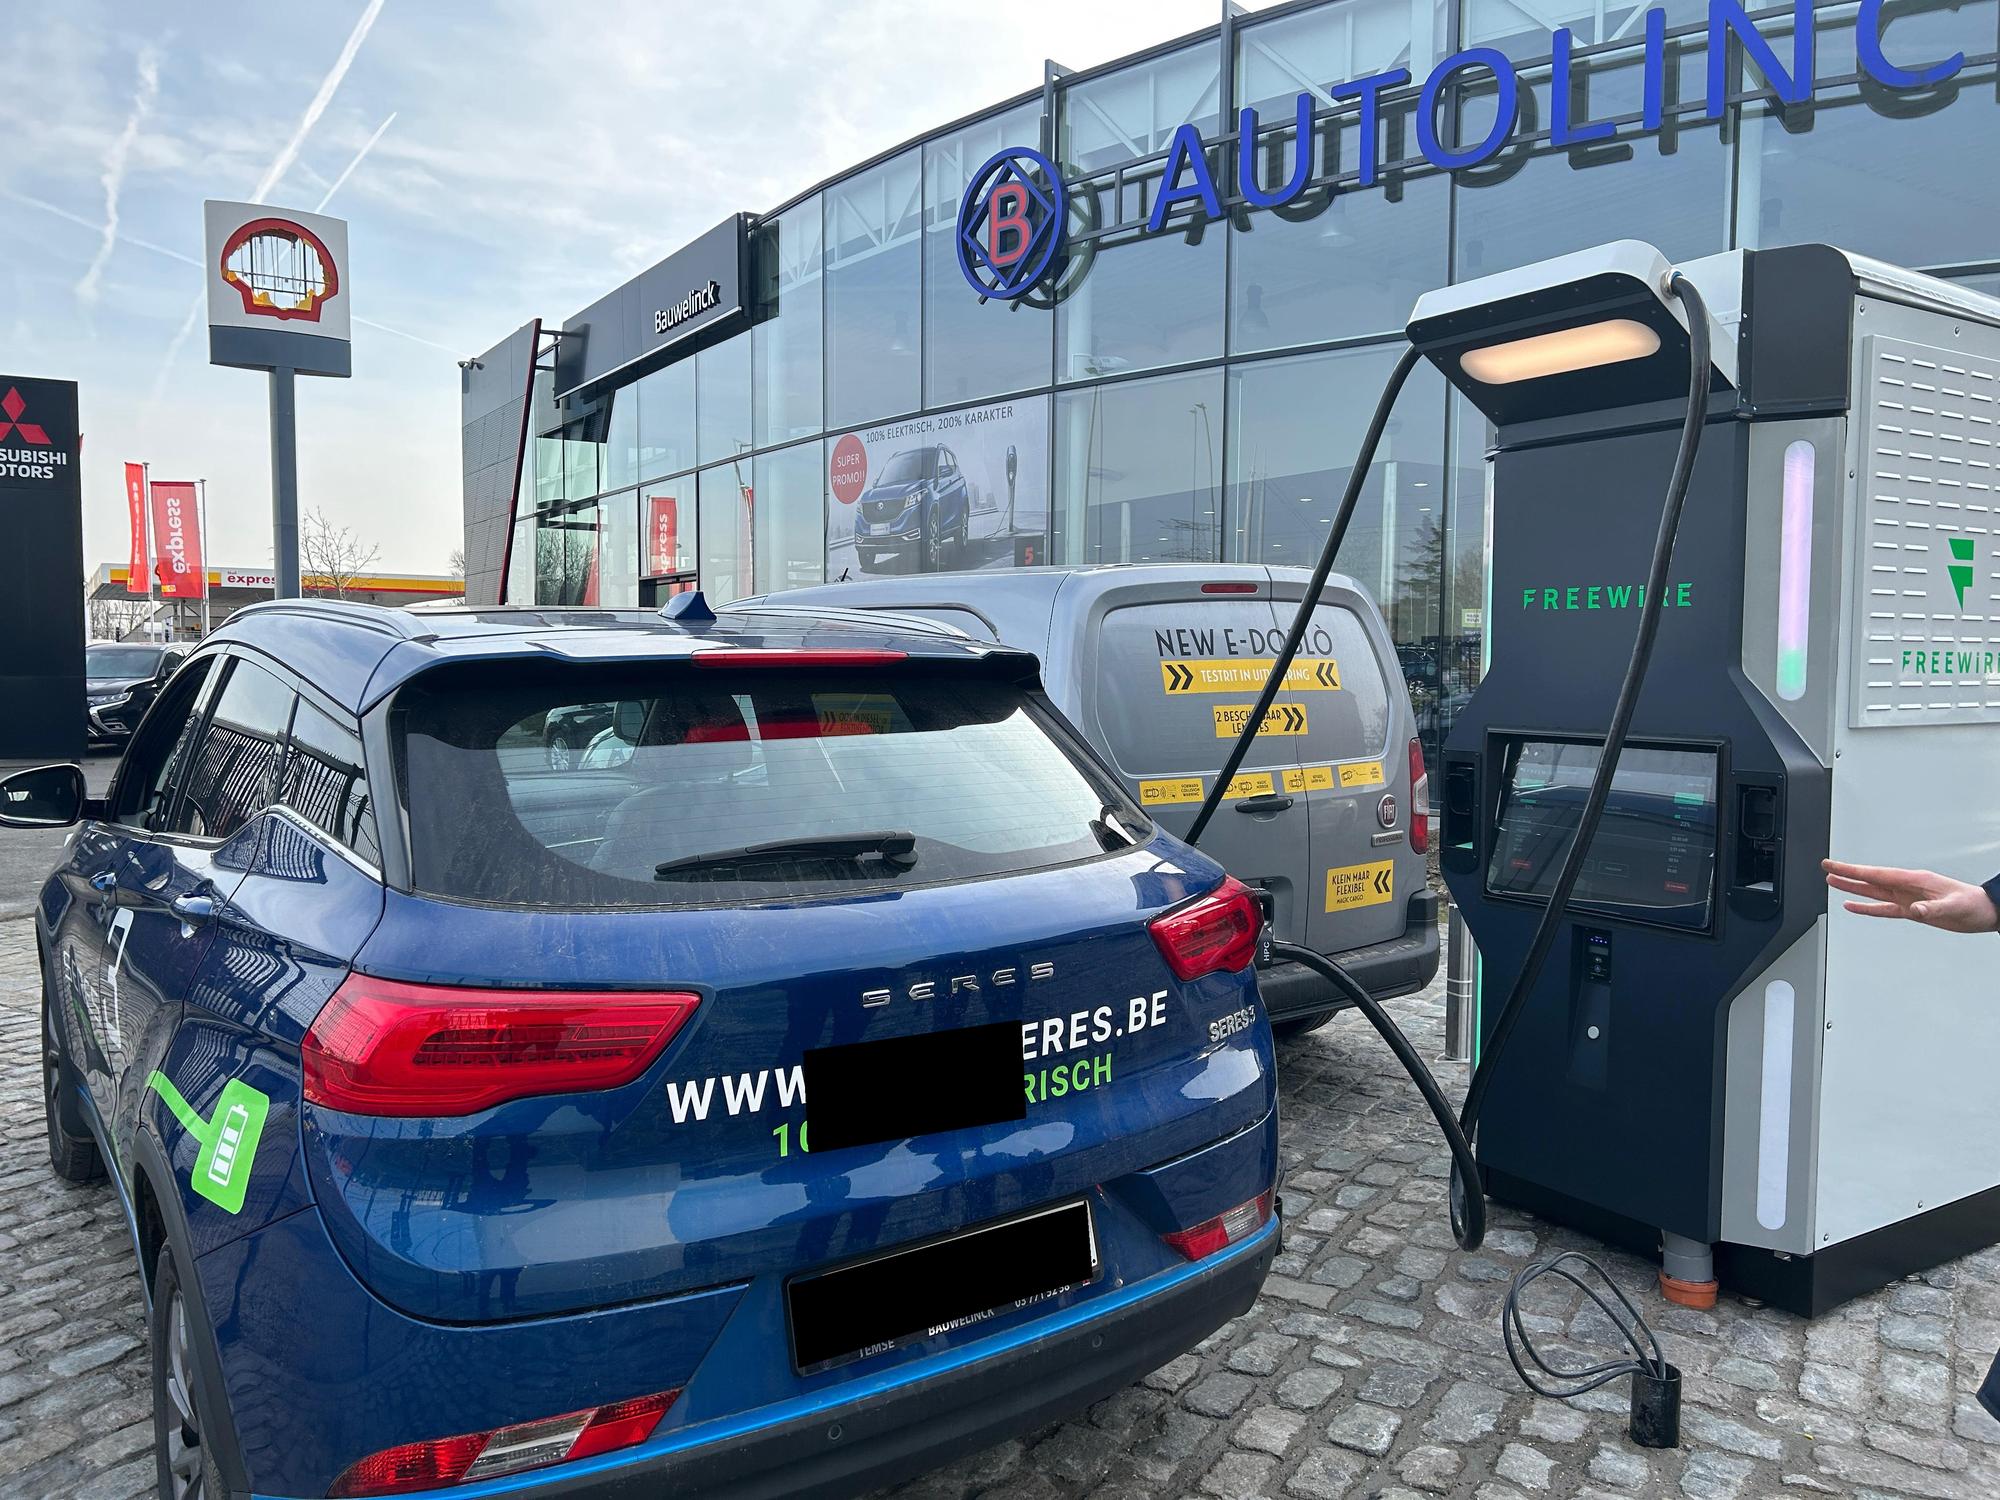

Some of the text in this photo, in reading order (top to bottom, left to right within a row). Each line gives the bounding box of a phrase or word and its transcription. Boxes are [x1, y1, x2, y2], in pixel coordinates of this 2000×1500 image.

[1148, 0, 1964, 232] AUTOLINC
[987, 180, 1032, 266] B
[654, 279, 717, 334] Bauwelinck
[865, 405, 1014, 444] 100% ELEKTRISCH, 200% KARAKTER
[0, 448, 67, 465] SUBISHI
[836, 452, 860, 469] SUPER
[0, 463, 54, 479] OTORS
[832, 469, 866, 486] PROMO!!
[659, 513, 669, 575] xpress
[227, 574, 276, 586] expres
[1154, 624, 1333, 657] NEW E-DOLÒ
[1200, 667, 1310, 683] TESTRIT IN UITERING
[1215, 709, 1281, 723] 2 BESCHAAR
[1232, 721, 1270, 734] LENES
[1383, 804, 1395, 820] FIAT
[1332, 870, 1371, 885] KLEIN MAAR
[1336, 881, 1365, 896] FLEXIBEL
[861, 961, 1055, 1009] SERES
[1209, 1008, 1249, 1043] SERES
[1024, 1053, 1112, 1103] RISCH
